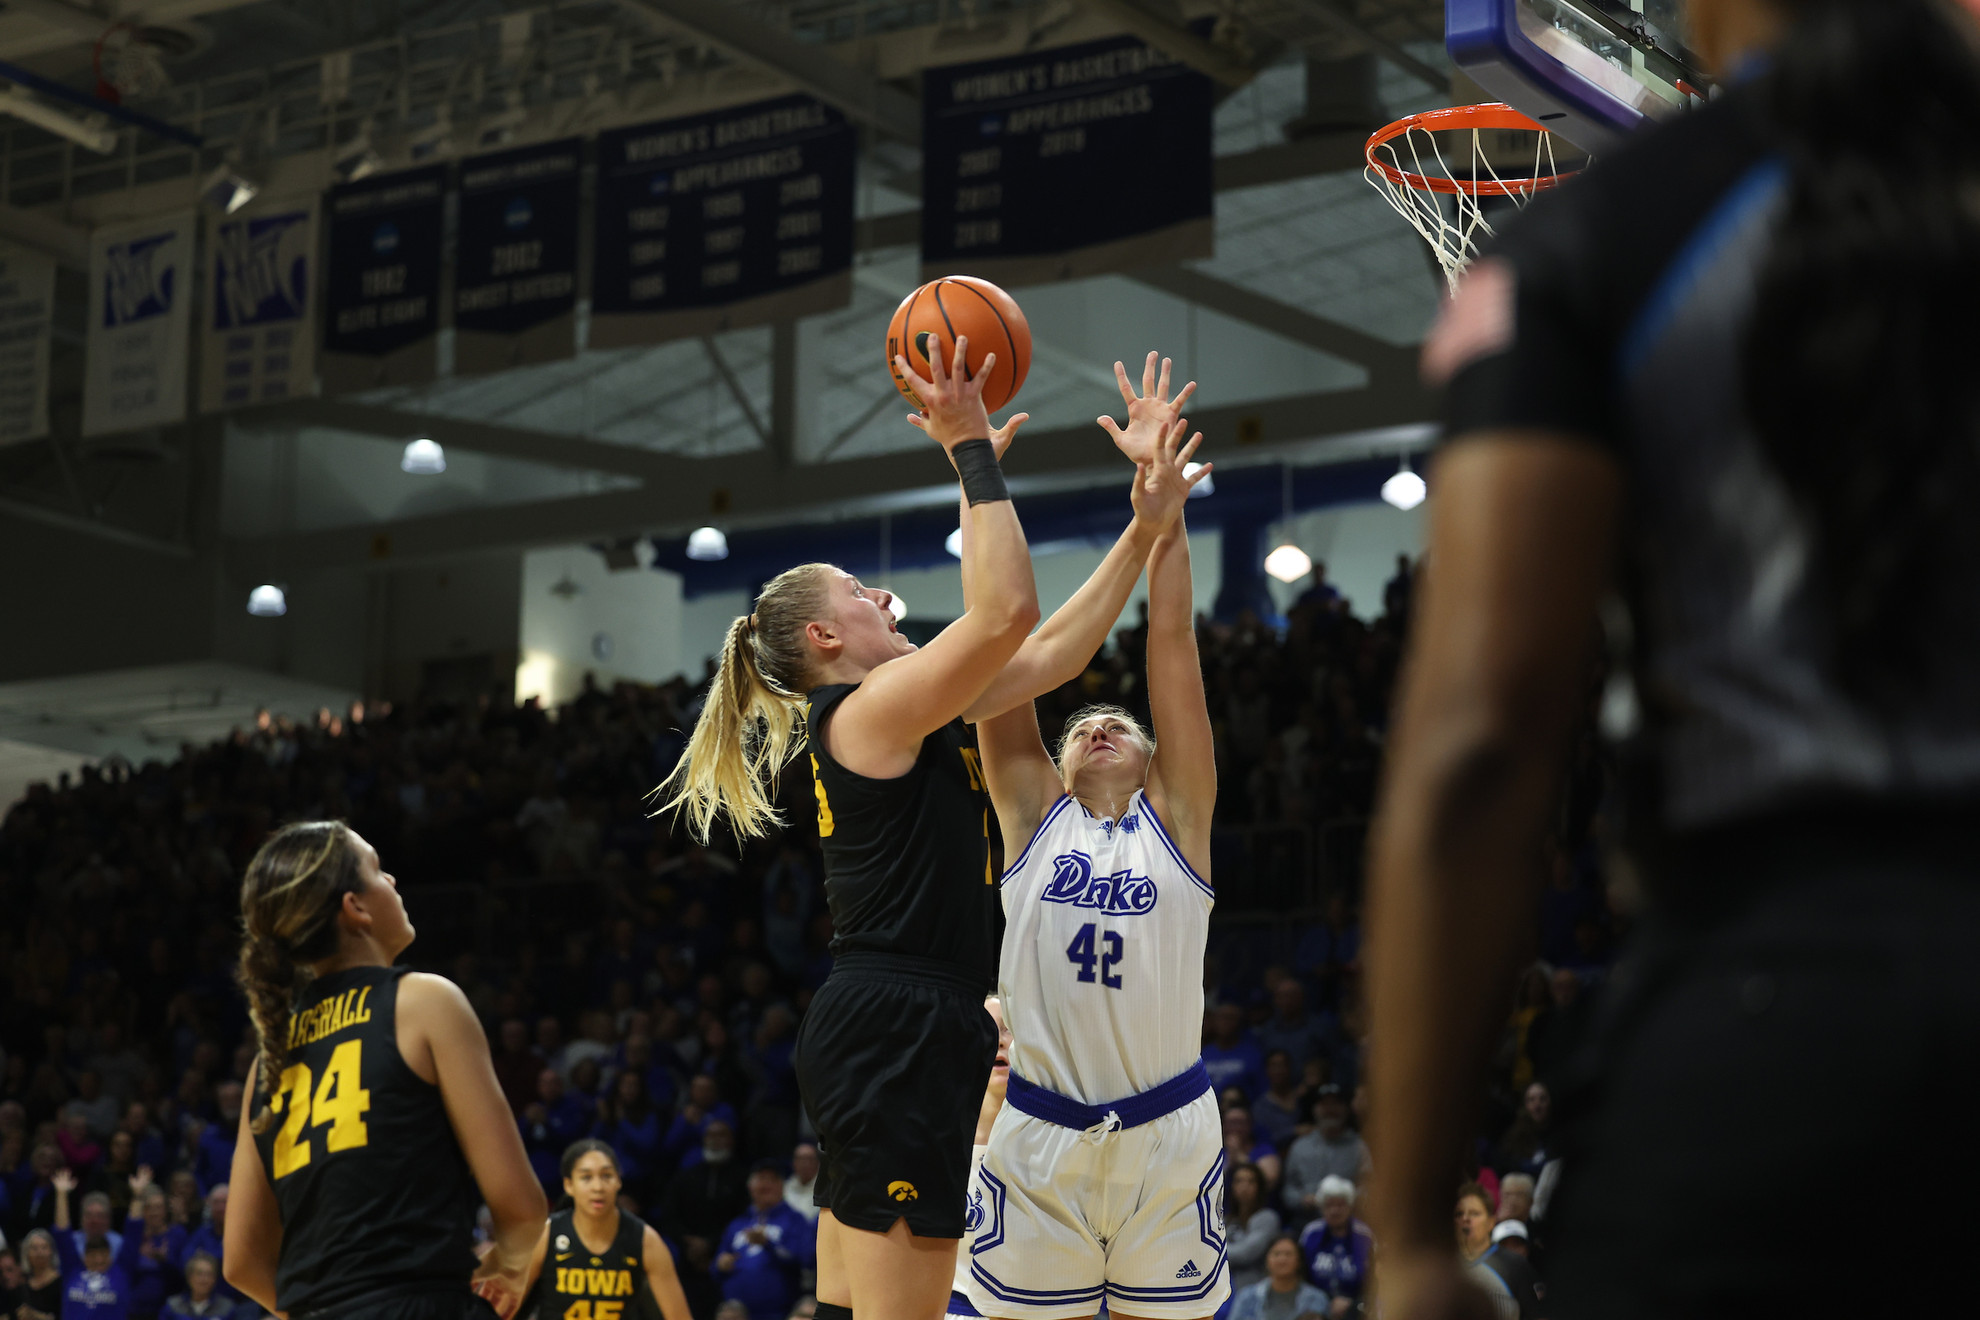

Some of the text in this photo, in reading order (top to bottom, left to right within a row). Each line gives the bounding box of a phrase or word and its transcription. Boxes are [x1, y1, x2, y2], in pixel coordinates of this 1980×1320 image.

[1066, 923, 1123, 990] 42
[286, 985, 372, 1051] ARSHALL
[270, 1038, 371, 1180] 24
[555, 1267, 634, 1296] IOWA
[1175, 1270, 1202, 1279] adidas
